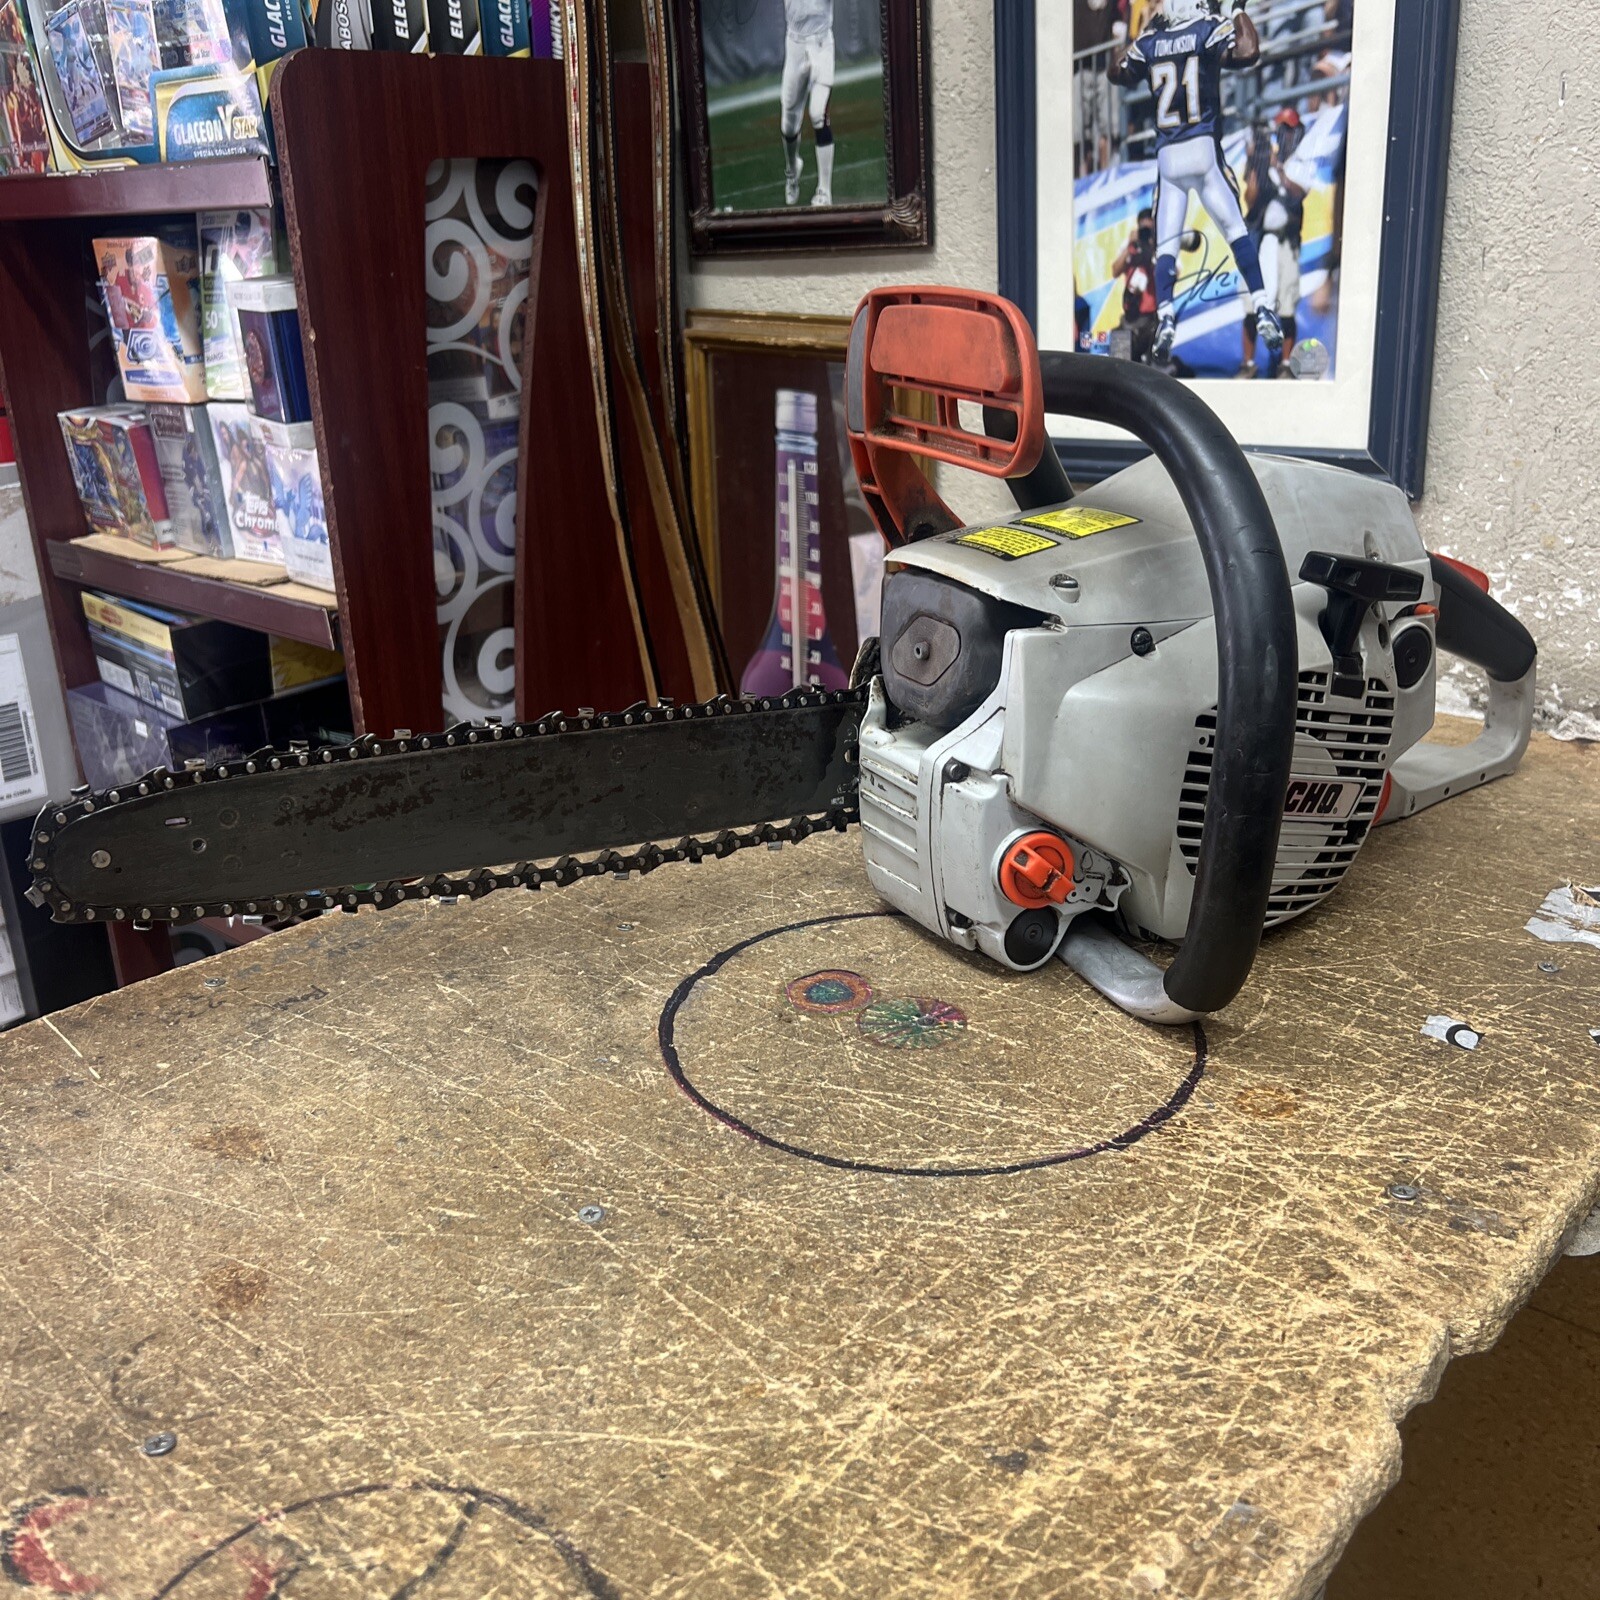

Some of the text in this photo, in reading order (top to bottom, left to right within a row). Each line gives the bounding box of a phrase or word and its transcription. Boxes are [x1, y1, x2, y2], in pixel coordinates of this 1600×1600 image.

[264, 0, 287, 48] GLAC
[1151, 56, 1200, 129] 21
[173, 119, 223, 146] GLACEON
[205, 311, 218, 330] 50
[1284, 781, 1344, 814] CHO
